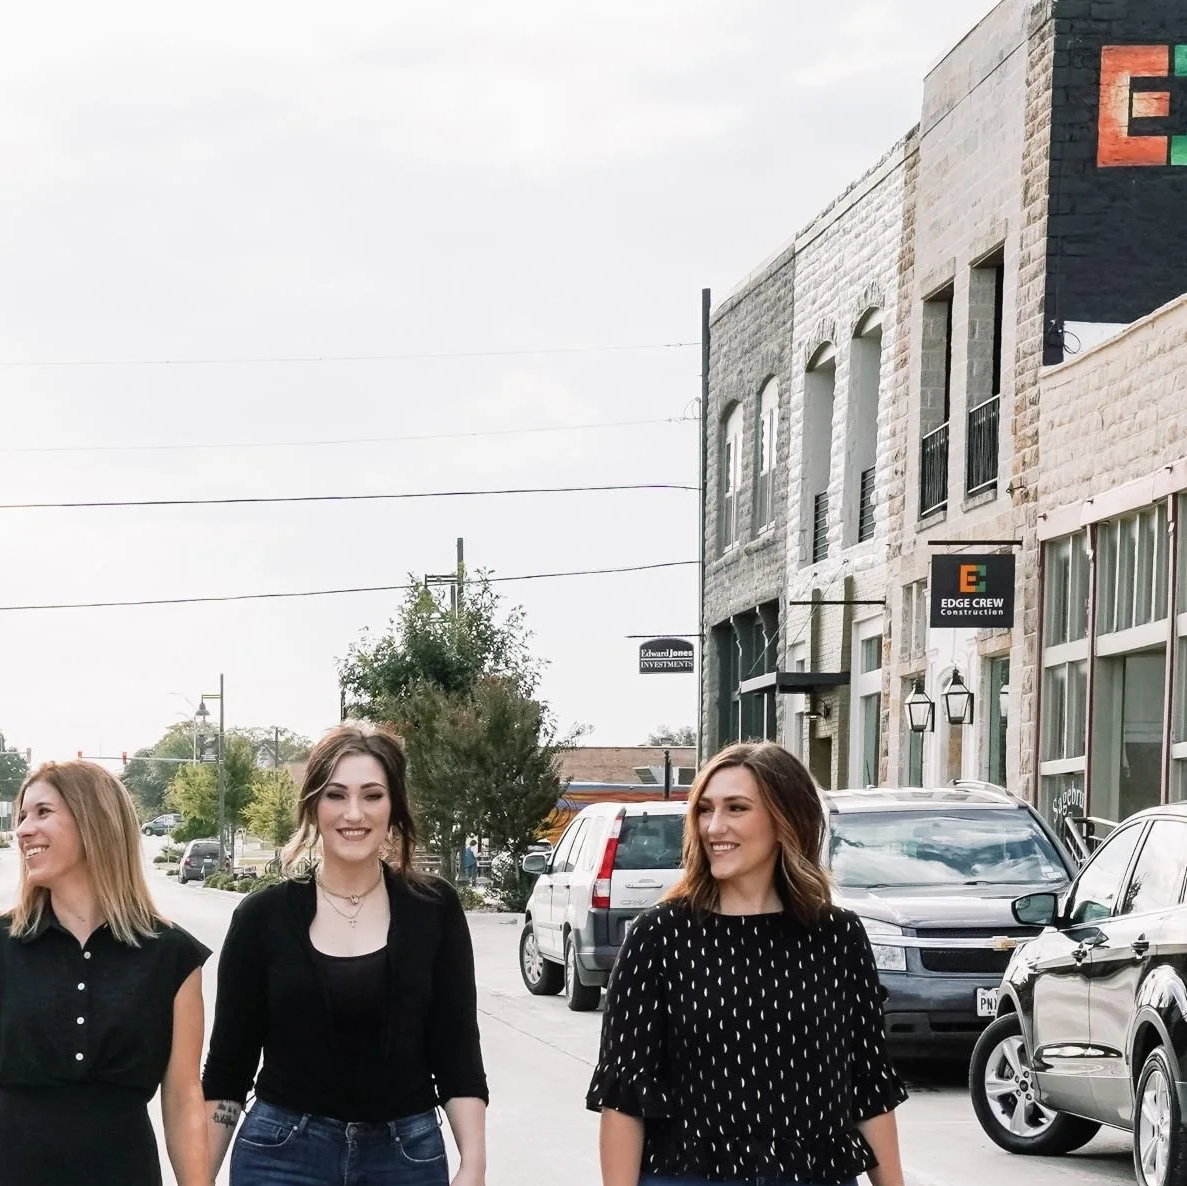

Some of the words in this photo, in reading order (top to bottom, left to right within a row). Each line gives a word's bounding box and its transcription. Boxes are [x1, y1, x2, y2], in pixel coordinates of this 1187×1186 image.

[941, 598, 971, 608] EDGE
[972, 598, 1004, 608] CREW
[940, 608, 1004, 616] Construction
[641, 648, 669, 658] Edward
[669, 648, 693, 658] Jones
[640, 660, 693, 669] INVESTMENTS
